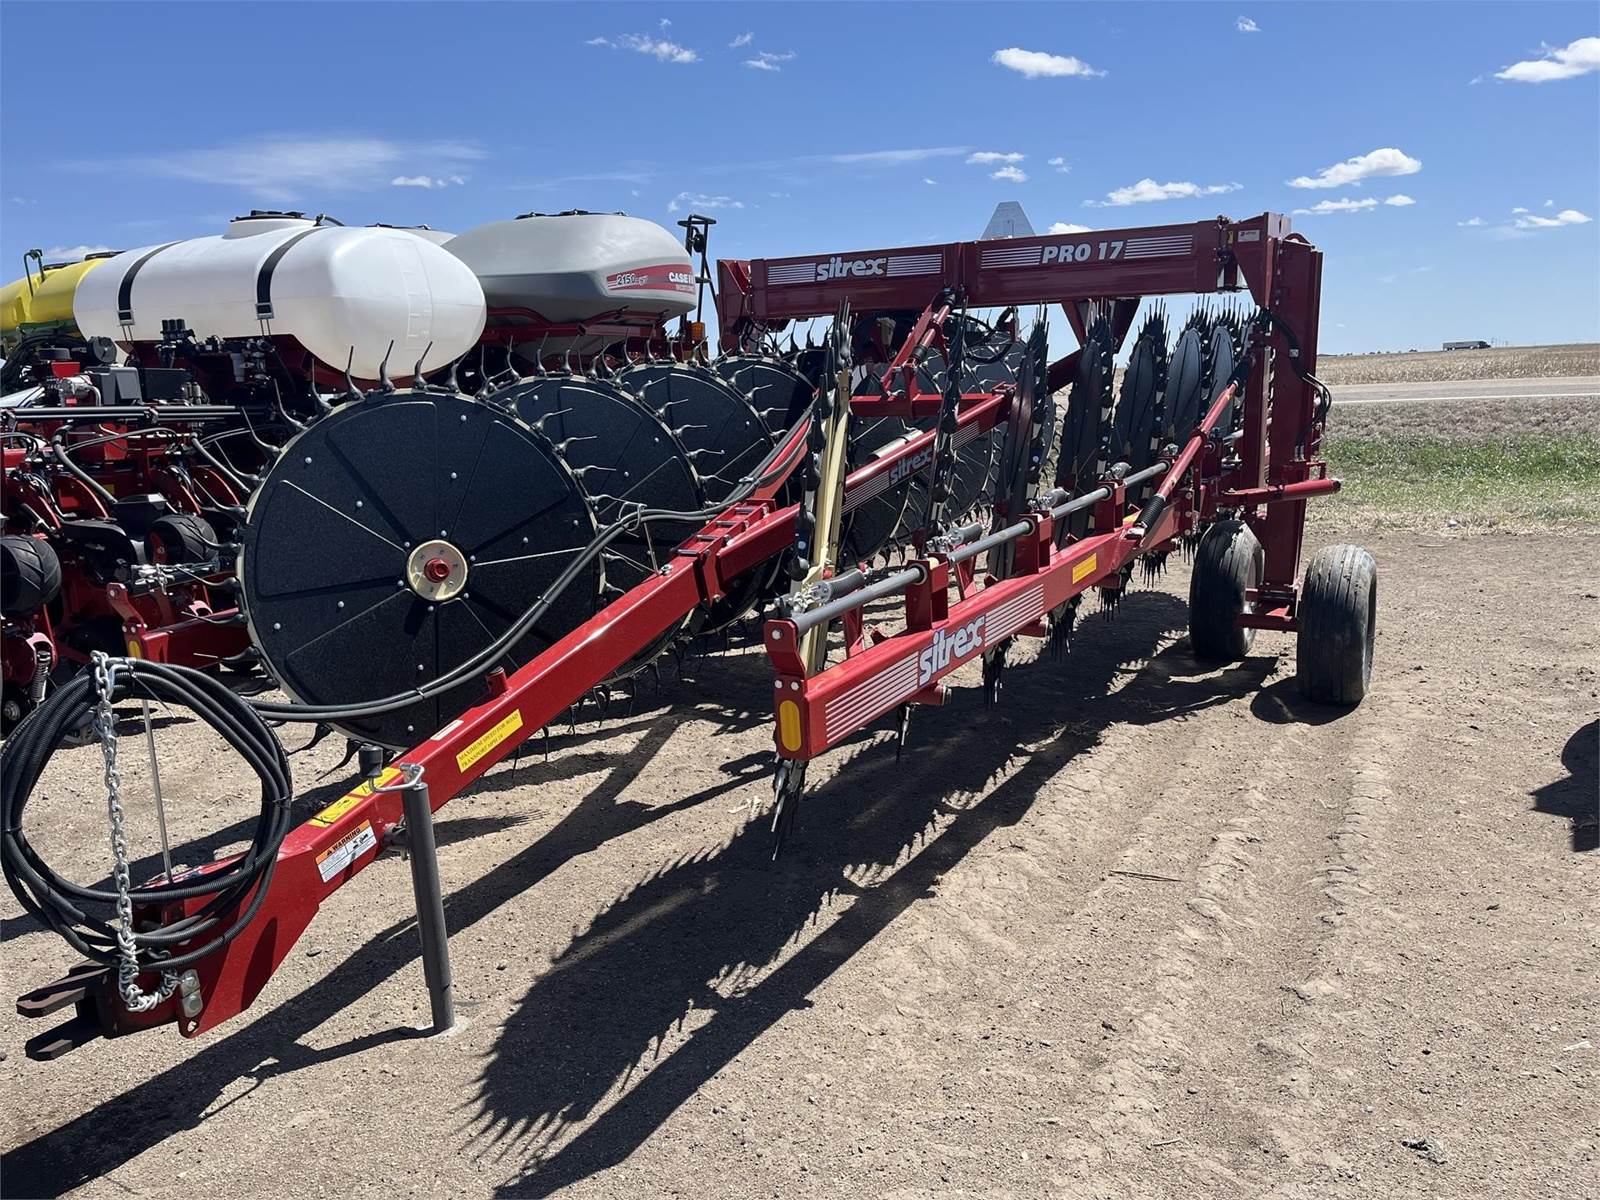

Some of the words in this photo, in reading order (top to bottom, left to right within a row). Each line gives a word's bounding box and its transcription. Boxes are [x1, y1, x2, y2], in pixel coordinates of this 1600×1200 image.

[1041, 243, 1091, 264] PRO
[1098, 241, 1124, 260] 17
[616, 273, 635, 287] 2150
[669, 271, 689, 284] CASE
[816, 257, 887, 281] sitrex
[918, 615, 986, 685] sitrex
[332, 827, 361, 851] WARNING
